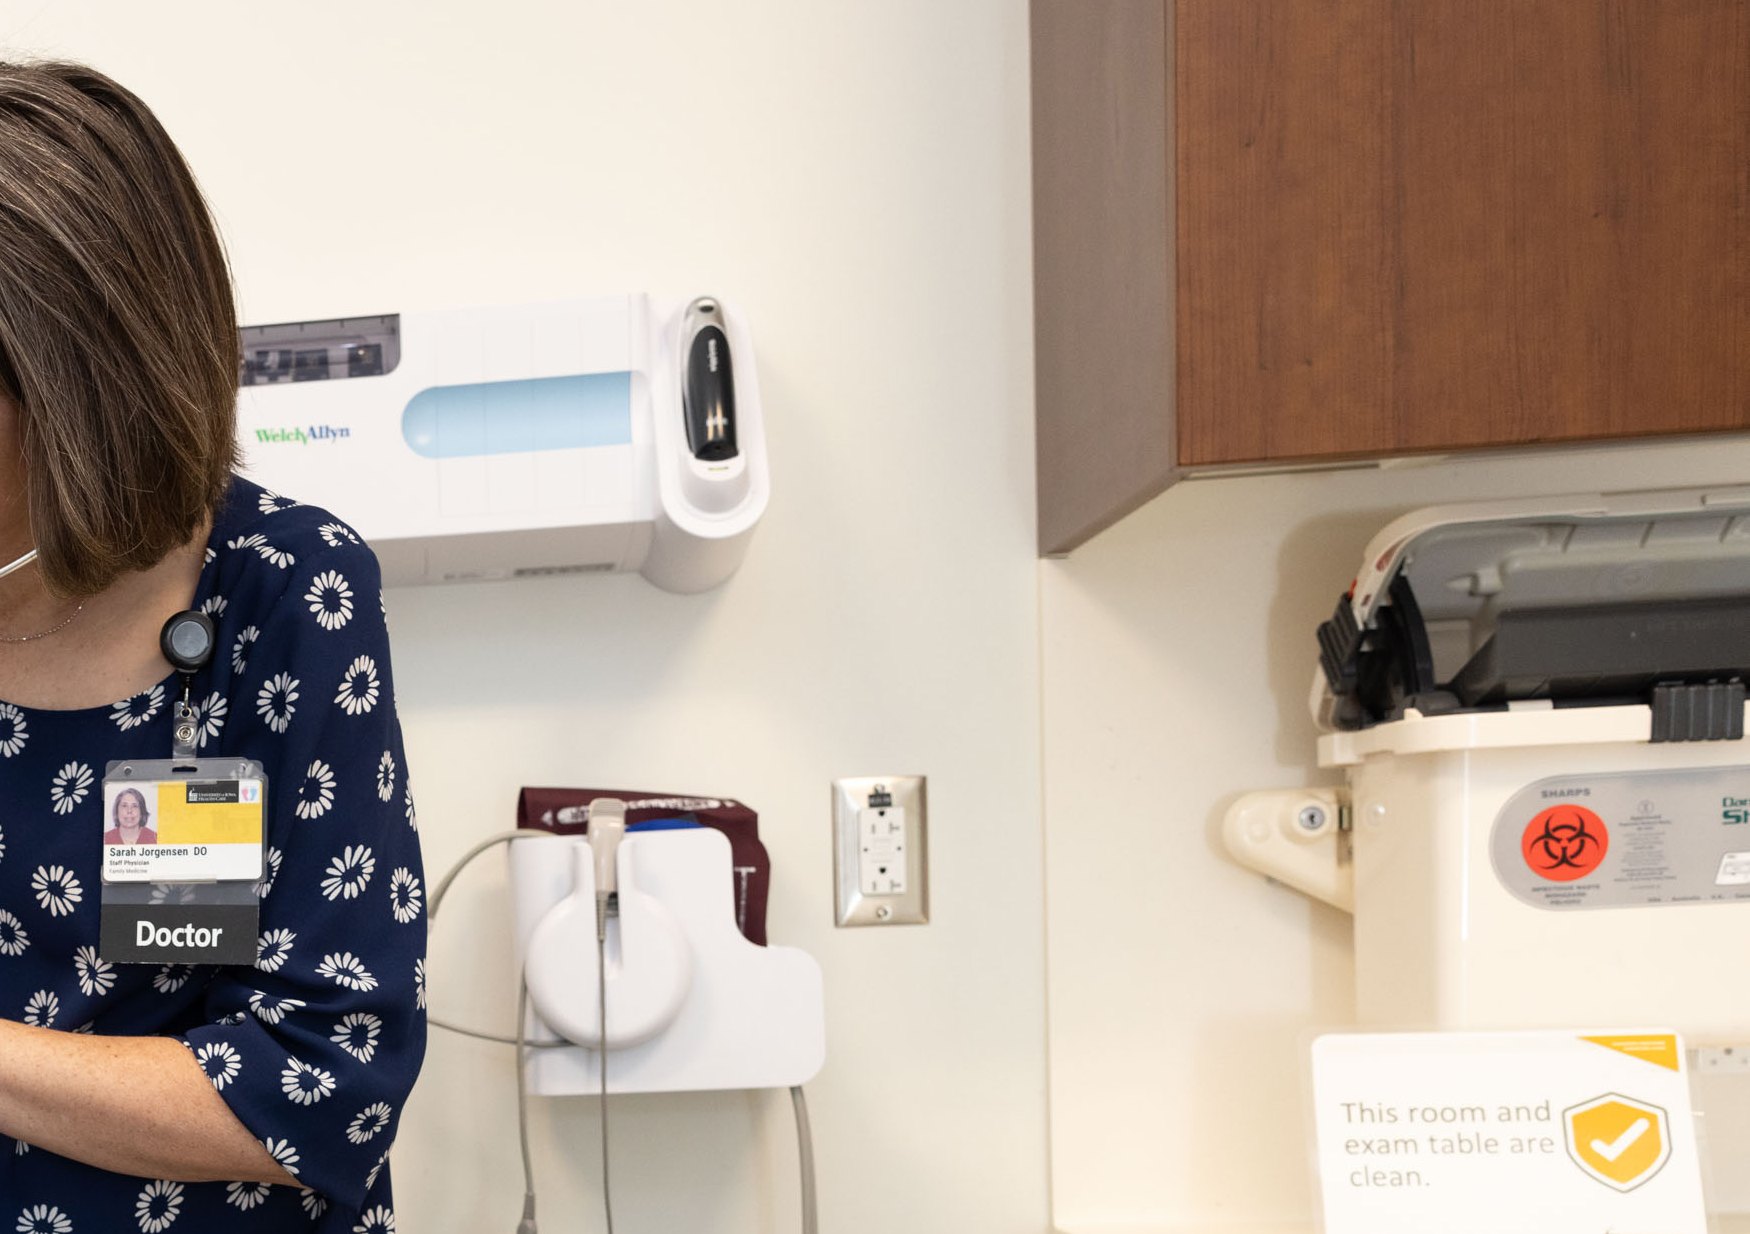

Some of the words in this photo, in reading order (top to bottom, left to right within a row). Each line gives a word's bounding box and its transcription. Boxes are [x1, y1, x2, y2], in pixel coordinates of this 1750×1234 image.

[1541, 788, 1591, 799] SHARPS
[109, 847, 136, 857] Sarah
[139, 847, 189, 858] Jorgensen
[193, 846, 208, 856] DO
[136, 920, 223, 947] Doctor
[1340, 1102, 1399, 1124] This
[1409, 1106, 1486, 1123] room
[1496, 1099, 1552, 1122] and
[1344, 1137, 1419, 1155] exam
[1428, 1132, 1499, 1155] table
[1509, 1136, 1556, 1154] are
[1350, 1165, 1431, 1188] clean.
